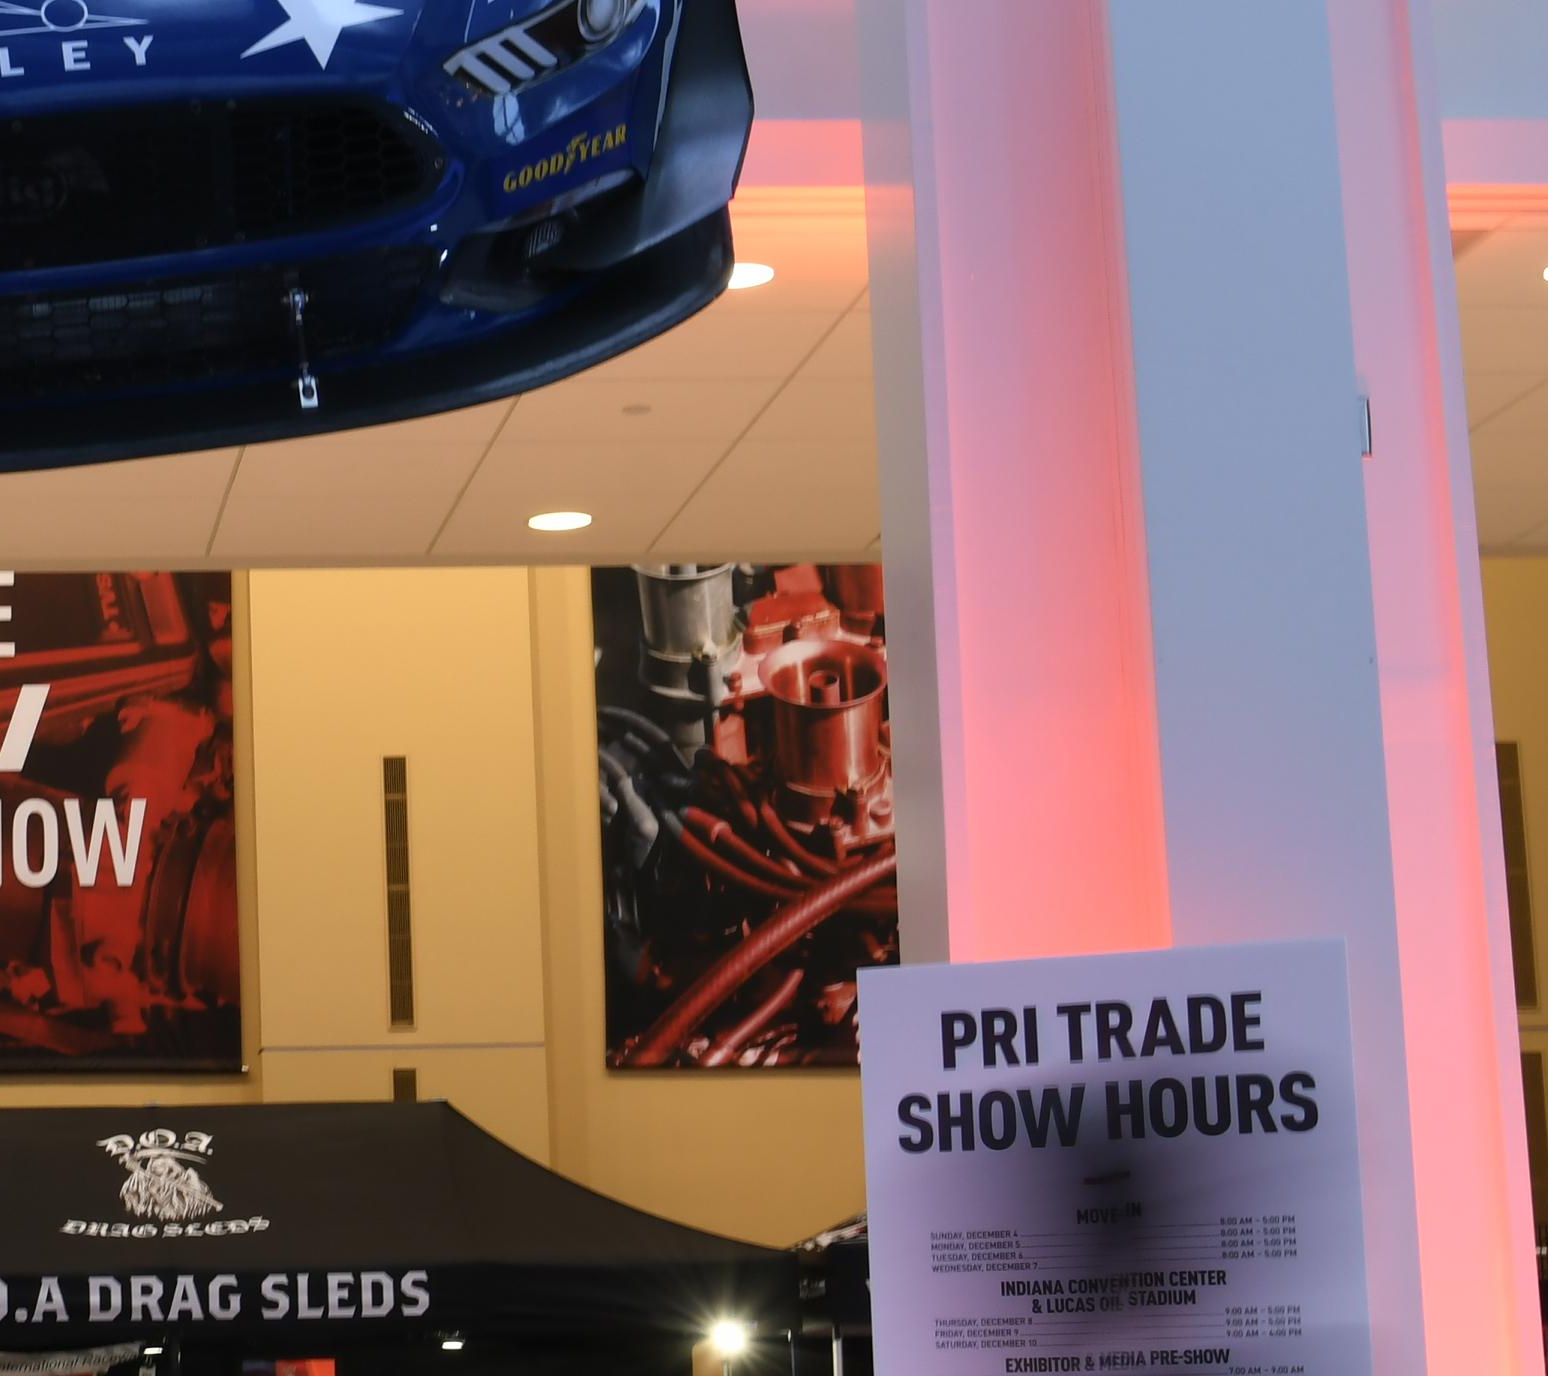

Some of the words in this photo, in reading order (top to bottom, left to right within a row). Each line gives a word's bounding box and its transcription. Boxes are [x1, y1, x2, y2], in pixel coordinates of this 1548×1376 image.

[503, 123, 627, 193] GOODYEAR
[940, 1005, 1039, 1072] PRI
[1057, 990, 1265, 1065] TRADE
[898, 1082, 1086, 1155] SHOW
[1106, 1071, 1319, 1141] HOURS
[930, 1232, 965, 1242] SUNDAY,
[966, 1230, 1011, 1240] DECEMBER
[1012, 1230, 1019, 1239] 4
[1239, 1216, 1253, 1225] AM
[1282, 1215, 1296, 1224] PM
[931, 1243, 967, 1252] MONDAY,
[968, 1241, 1014, 1250] DECEMBER
[1015, 1241, 1021, 1249] 5
[1240, 1228, 1254, 1237] AM
[1282, 1226, 1296, 1235] PM
[931, 1254, 970, 1263] TUESDAY,
[971, 1252, 1016, 1261] DECEMBER
[1017, 1252, 1024, 1260] 6
[932, 1264, 984, 1273] WEDNESDAY,
[985, 1263, 1031, 1272] DECEMBER
[1032, 1262, 1039, 1271] 7
[88, 1273, 242, 1322] DRAG
[261, 1269, 431, 1320] SLEDS
[1000, 1280, 1064, 1297] INDIANA
[1068, 1271, 1165, 1295] CONVENTION
[1169, 1269, 1227, 1287] CENTER
[1031, 1299, 1043, 1314] &
[1046, 1297, 1096, 1314] LUCAS
[1128, 1289, 1197, 1307] STADIUM
[935, 1318, 979, 1328] THURSDAY,
[980, 1317, 1027, 1327] DECEMBER
[935, 1330, 966, 1339] FRIDAY,
[967, 1329, 1012, 1338] DECEMBER
[935, 1340, 979, 1350] SATURDAY,
[980, 1339, 1026, 1349] DECEMBER
[1005, 1356, 1082, 1374] EXHIBITOR
[1084, 1355, 1095, 1372] &
[1099, 1351, 1147, 1371] MEDIA
[1150, 1348, 1231, 1366] PRE-SHOW
